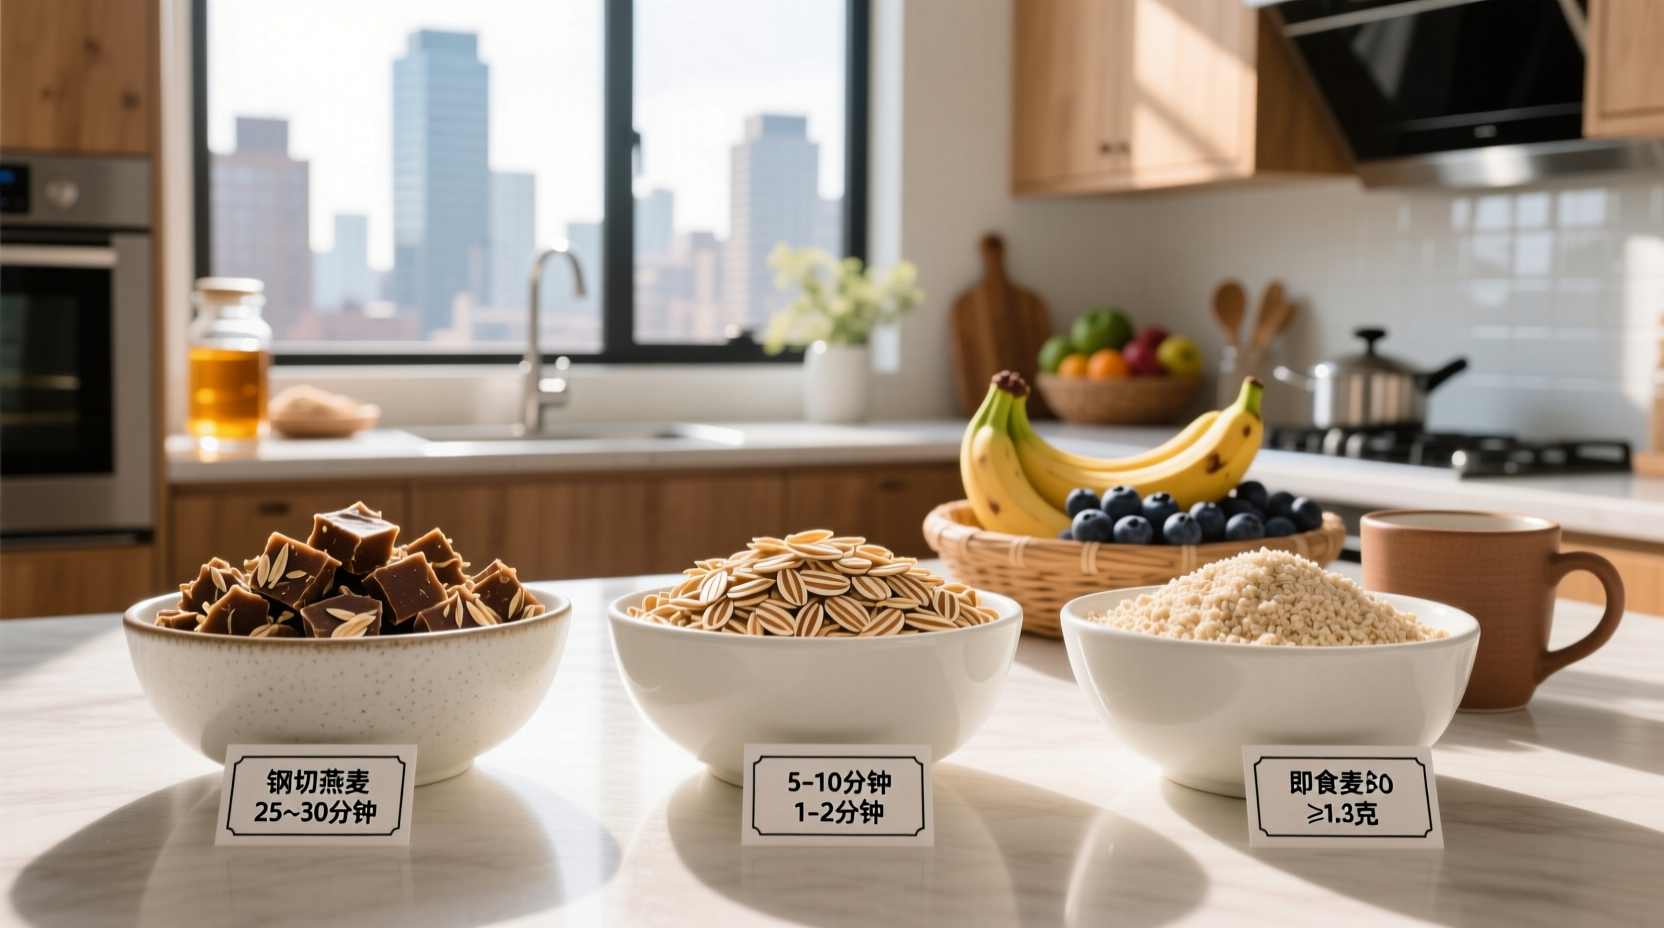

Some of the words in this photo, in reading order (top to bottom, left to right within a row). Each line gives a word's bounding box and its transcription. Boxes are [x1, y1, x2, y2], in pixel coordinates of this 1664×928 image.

[266, 768, 370, 794] 钢切燕麦
[788, 769, 892, 795] 5-10分钟
[794, 799, 884, 824] 1-2分钟
[1307, 800, 1379, 826] ≥1.3克
